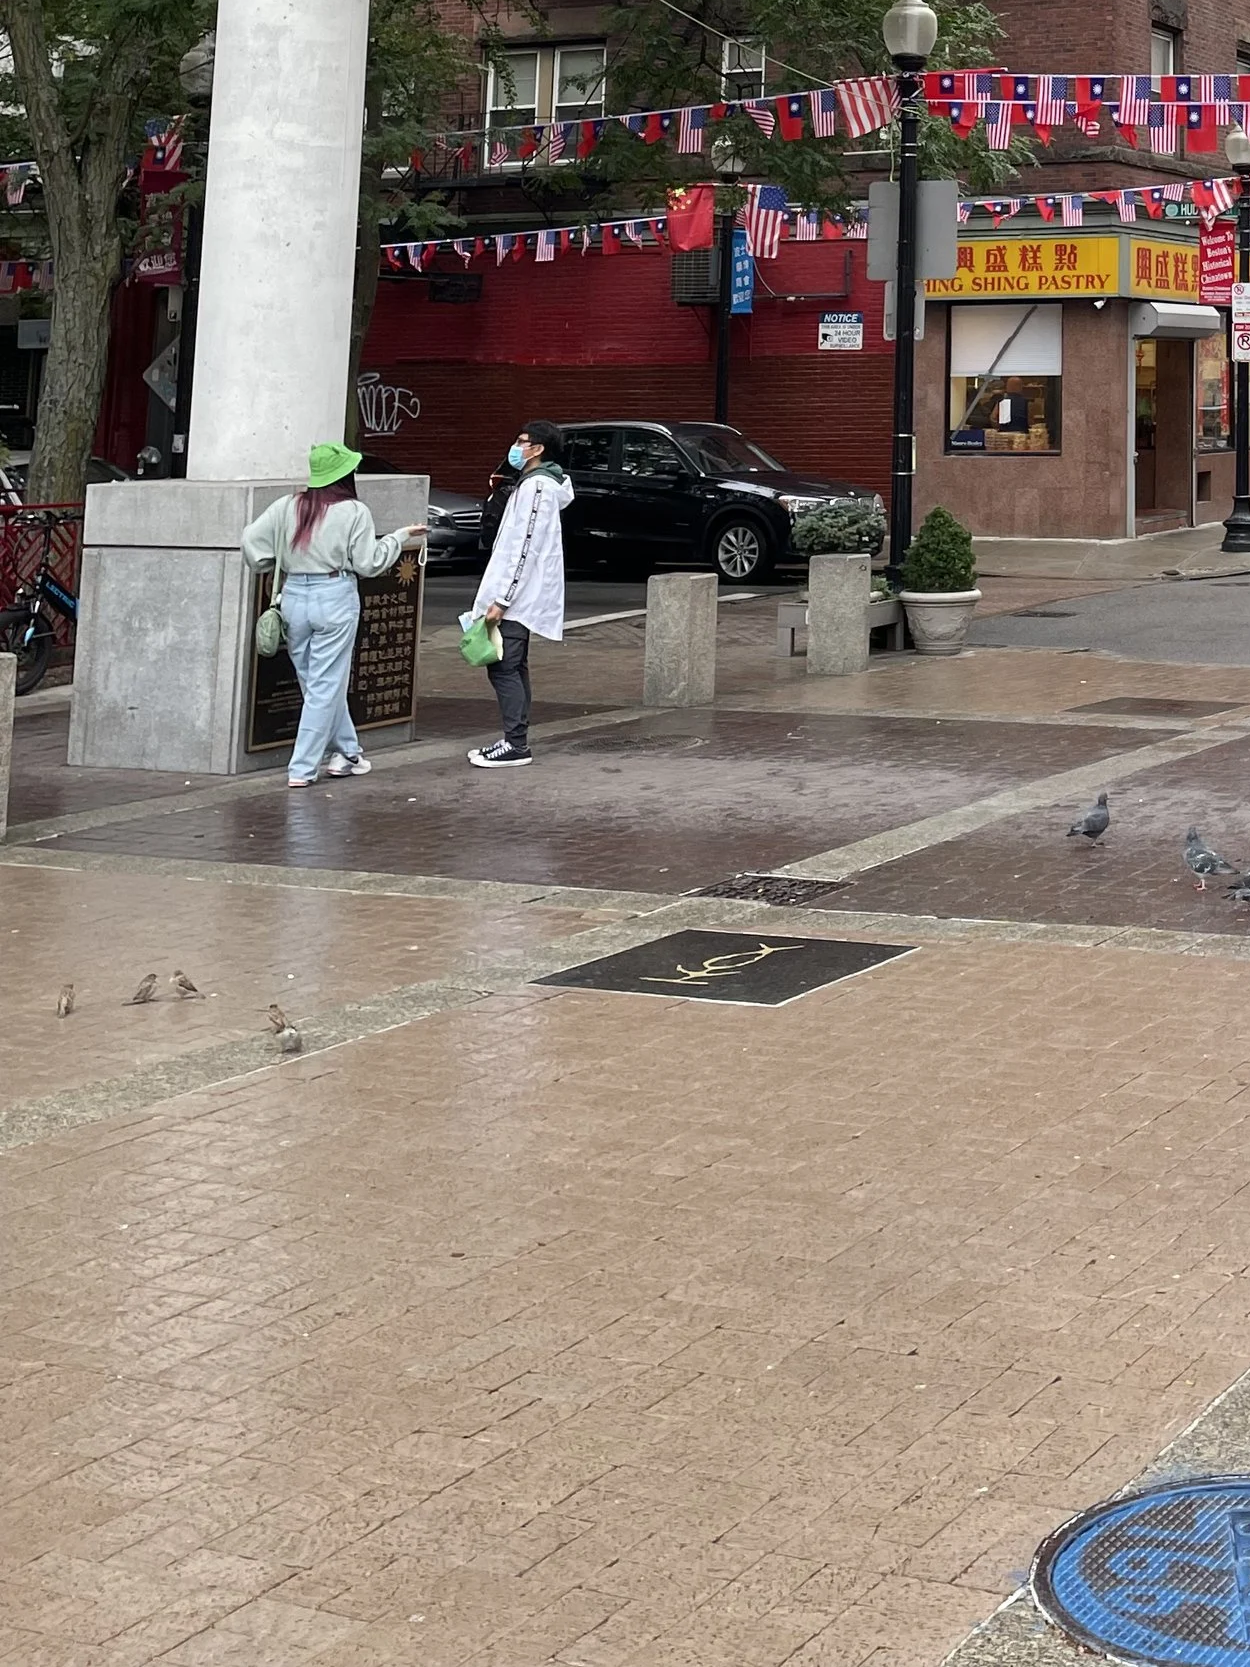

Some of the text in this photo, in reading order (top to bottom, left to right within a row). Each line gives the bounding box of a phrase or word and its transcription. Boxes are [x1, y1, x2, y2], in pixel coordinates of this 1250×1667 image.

[1201, 235, 1226, 246] Welcome
[1206, 245, 1232, 258] Boston's
[956, 244, 1077, 273] 興盛糕點
[1201, 256, 1232, 271] Historical
[972, 276, 1030, 292] SHING
[1038, 274, 1111, 290] PASTRY
[1200, 271, 1233, 284] Chinatown
[824, 314, 858, 323] NOTICE
